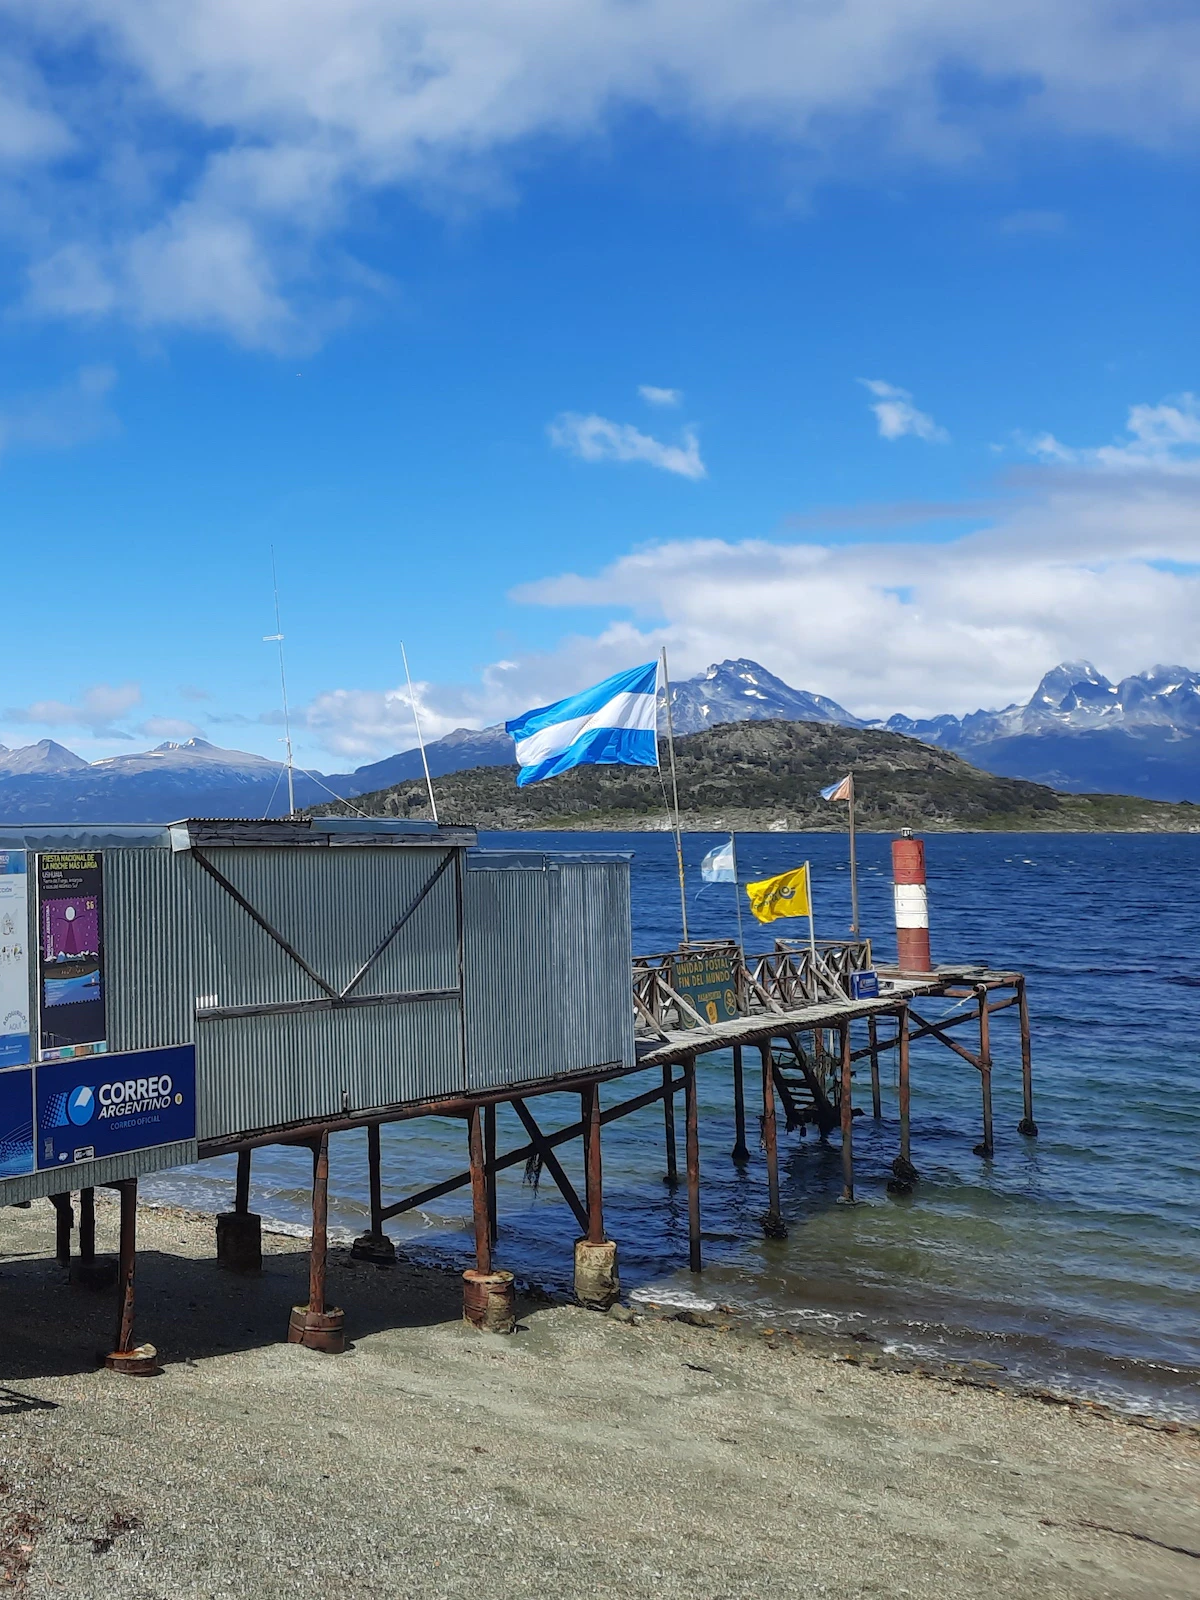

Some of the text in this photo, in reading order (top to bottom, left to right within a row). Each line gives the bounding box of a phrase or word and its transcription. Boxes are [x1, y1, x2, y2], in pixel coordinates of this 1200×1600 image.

[42, 855, 60, 863] FIESTA
[61, 854, 87, 862] NACIONAL
[42, 862, 50, 870] LA
[50, 862, 68, 870] NOCHE
[80, 861, 98, 869] LARGA
[86, 901, 95, 910] $6
[676, 958, 729, 975] UNIDAD POSTAL
[679, 970, 730, 988] FIN DEL MUNDO
[98, 1074, 173, 1106] CORREO
[98, 1095, 171, 1120] ARGENTINO
[110, 1114, 161, 1131] CORREO OFICIAL
